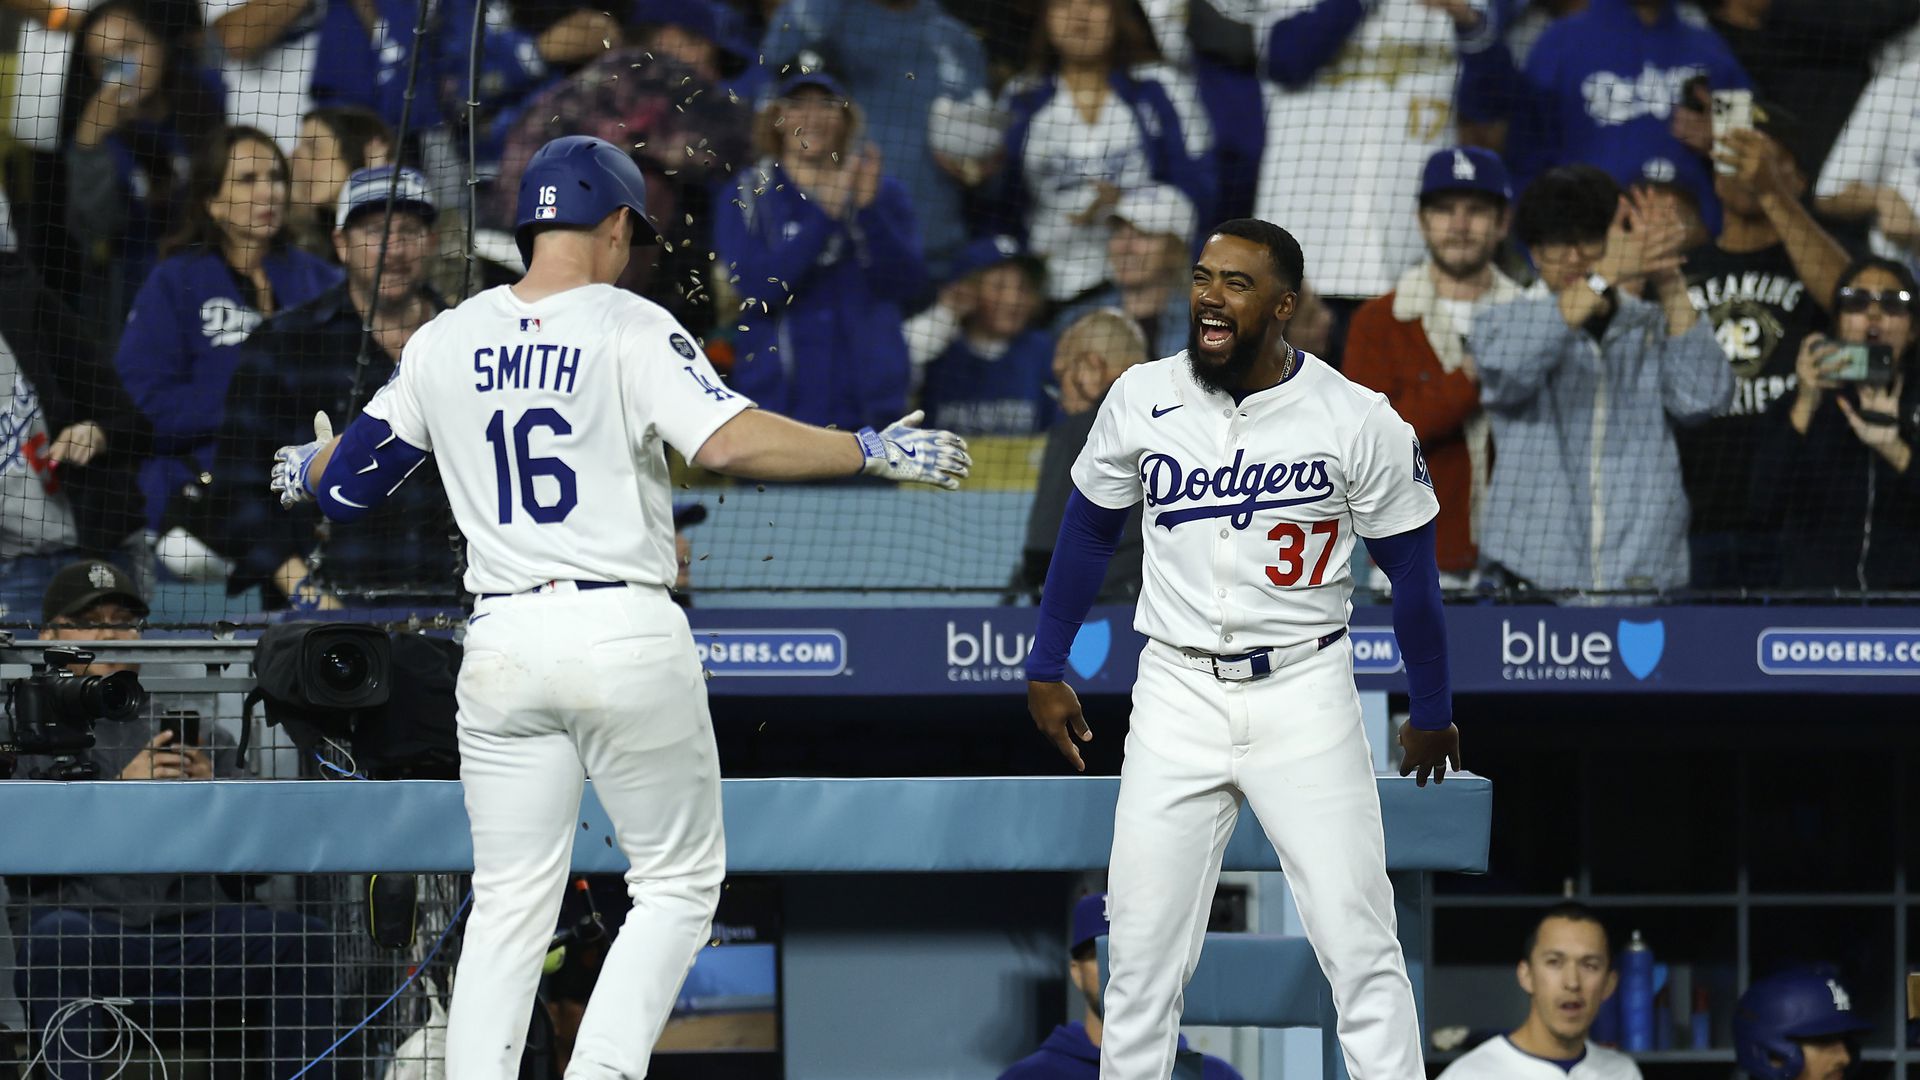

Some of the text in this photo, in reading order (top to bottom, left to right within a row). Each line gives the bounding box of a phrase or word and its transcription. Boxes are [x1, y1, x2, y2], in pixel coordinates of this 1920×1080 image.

[539, 185, 557, 206] 16
[1688, 271, 1803, 312] REAKING
[1715, 317, 1761, 361] 42
[474, 344, 581, 393] SMITH
[684, 366, 734, 401] LA
[485, 407, 578, 525] 16
[1140, 448, 1335, 533] Dodgers
[1265, 518, 1340, 587] 37
[696, 642, 835, 663] DGERS.COM
[947, 619, 1036, 666] blu
[1502, 618, 1612, 665] blue
[1771, 640, 1920, 662] DODGERS.CO
[947, 667, 1026, 682] CALIFOR
[1502, 666, 1611, 680] CALIFORNIA
